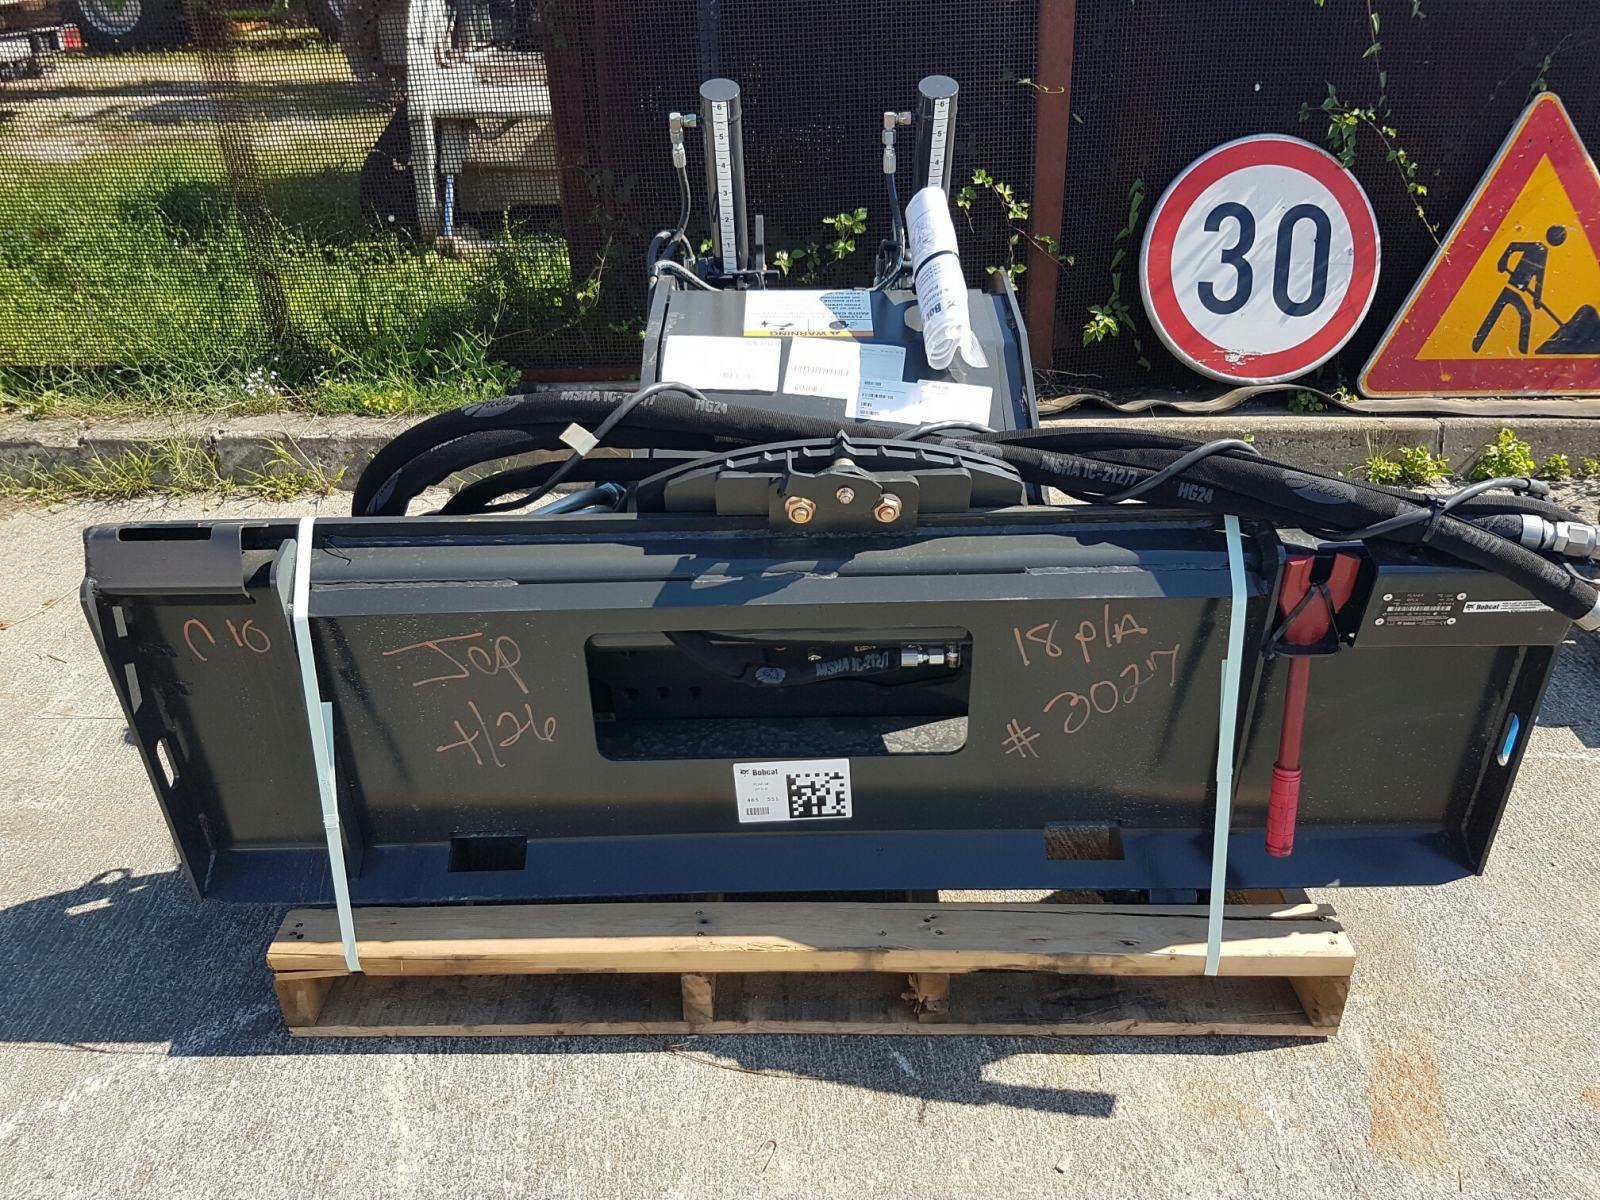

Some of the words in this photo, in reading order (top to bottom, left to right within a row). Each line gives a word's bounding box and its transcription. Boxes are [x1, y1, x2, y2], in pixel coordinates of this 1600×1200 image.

[1198, 202, 1332, 317] 30
[1040, 454, 1080, 477] MSHA
[1176, 481, 1215, 504] HG24
[1013, 619, 1063, 667] 18
[752, 768, 779, 776] Bobcat
